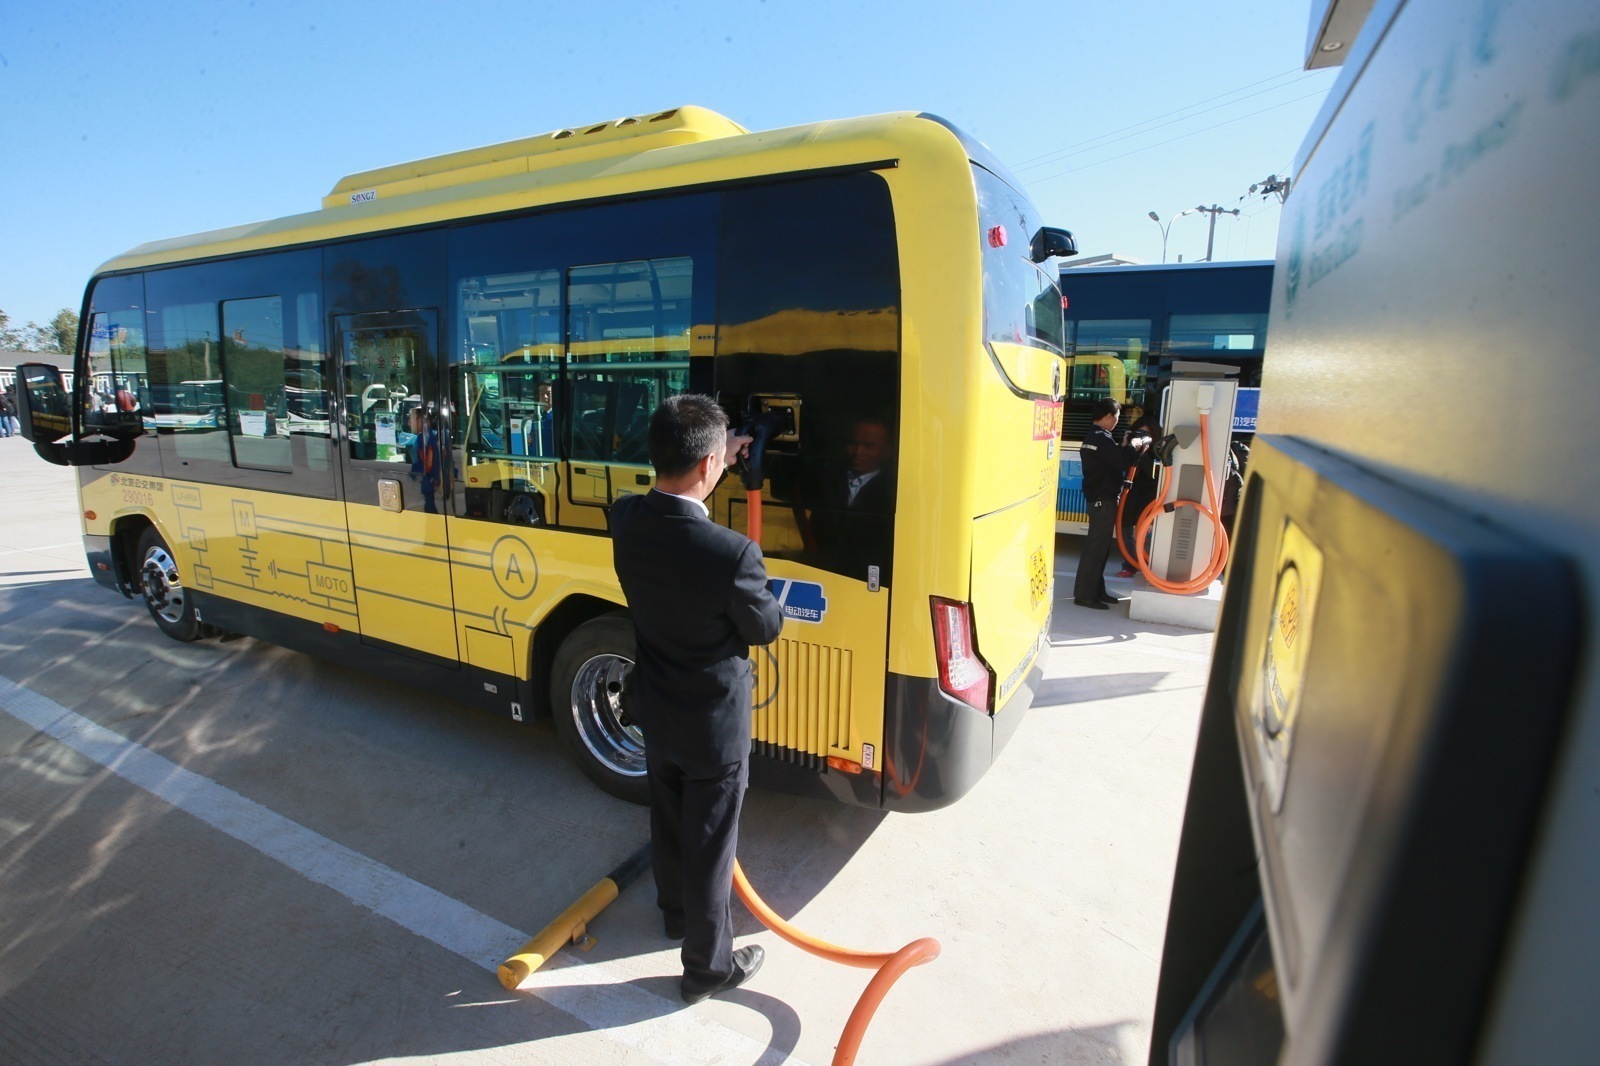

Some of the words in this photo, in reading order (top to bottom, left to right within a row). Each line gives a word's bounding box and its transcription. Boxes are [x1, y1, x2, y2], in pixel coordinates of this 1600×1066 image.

[351, 191, 375, 204] SONGZ
[120, 477, 164, 492] 北京公交集团
[122, 489, 153, 506] 290016
[239, 510, 250, 527] M
[505, 552, 525, 584] A
[315, 574, 348, 593] MOTO
[785, 605, 818, 619] 电动汽车
